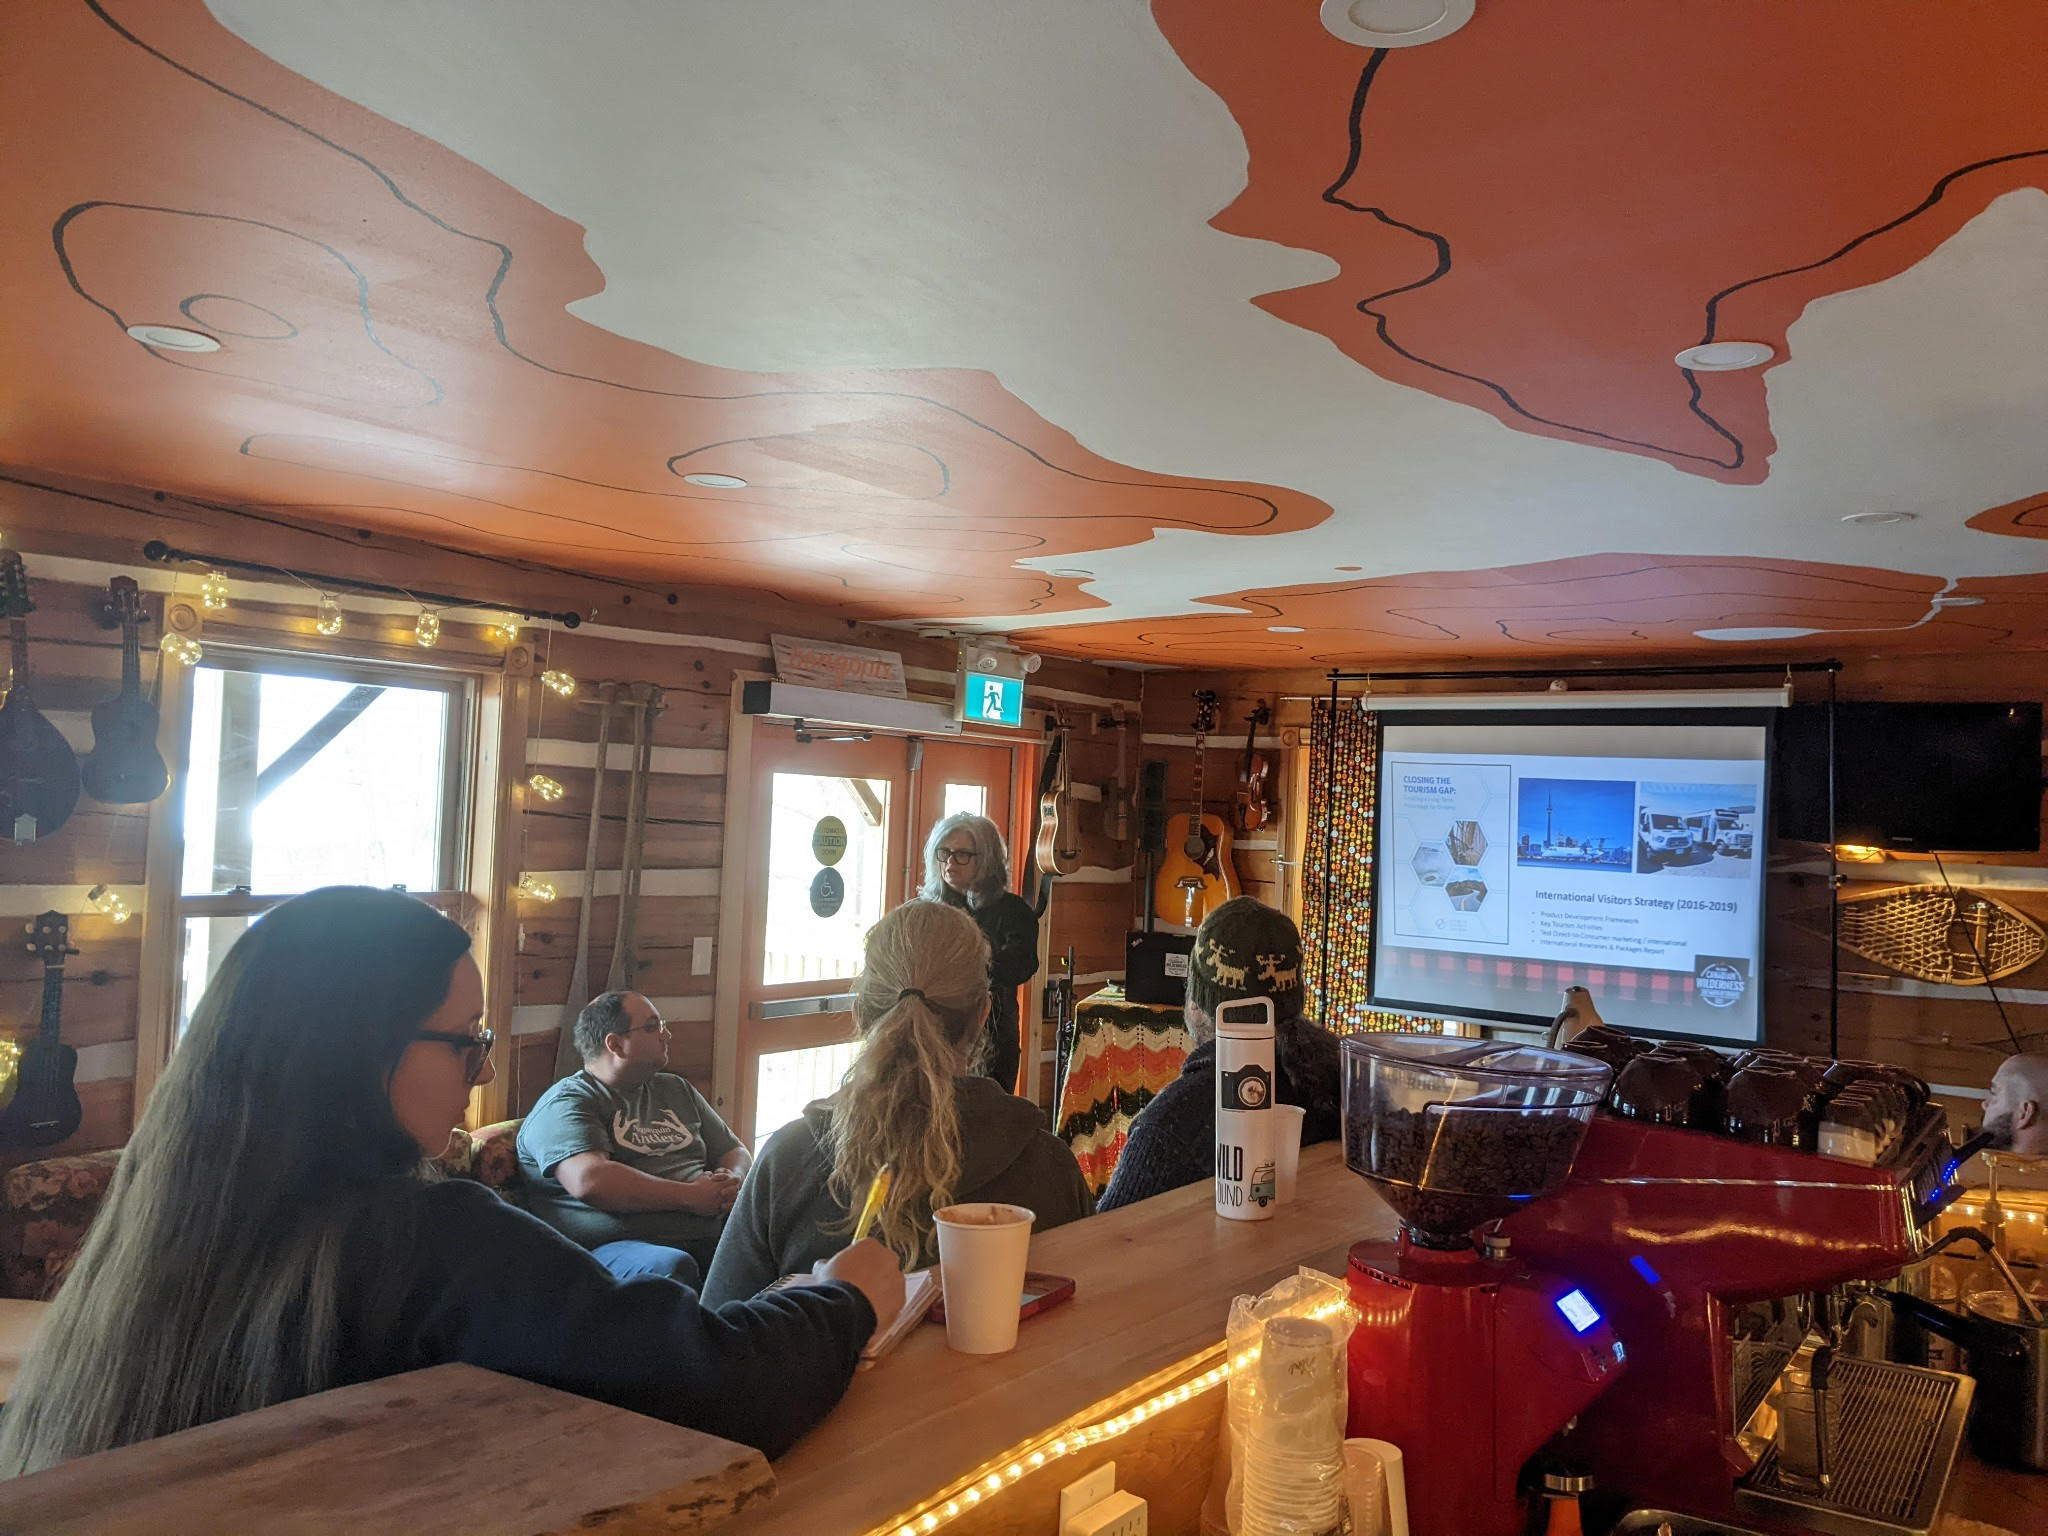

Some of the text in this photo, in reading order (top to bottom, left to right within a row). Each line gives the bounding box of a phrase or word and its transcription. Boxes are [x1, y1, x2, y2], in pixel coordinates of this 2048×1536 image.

[1403, 776, 1451, 785] CLOSING THE
[1403, 785, 1457, 795] TOURISM GAP:
[1535, 890, 1738, 914] International Visitors Strategy (2016-2019)
[1540, 920, 1551, 928] Key
[1552, 921, 1575, 929] Tourism
[1540, 939, 1577, 948] International
[1696, 978, 1745, 992] WILDERNESS
[632, 1132, 684, 1144] Antlers
